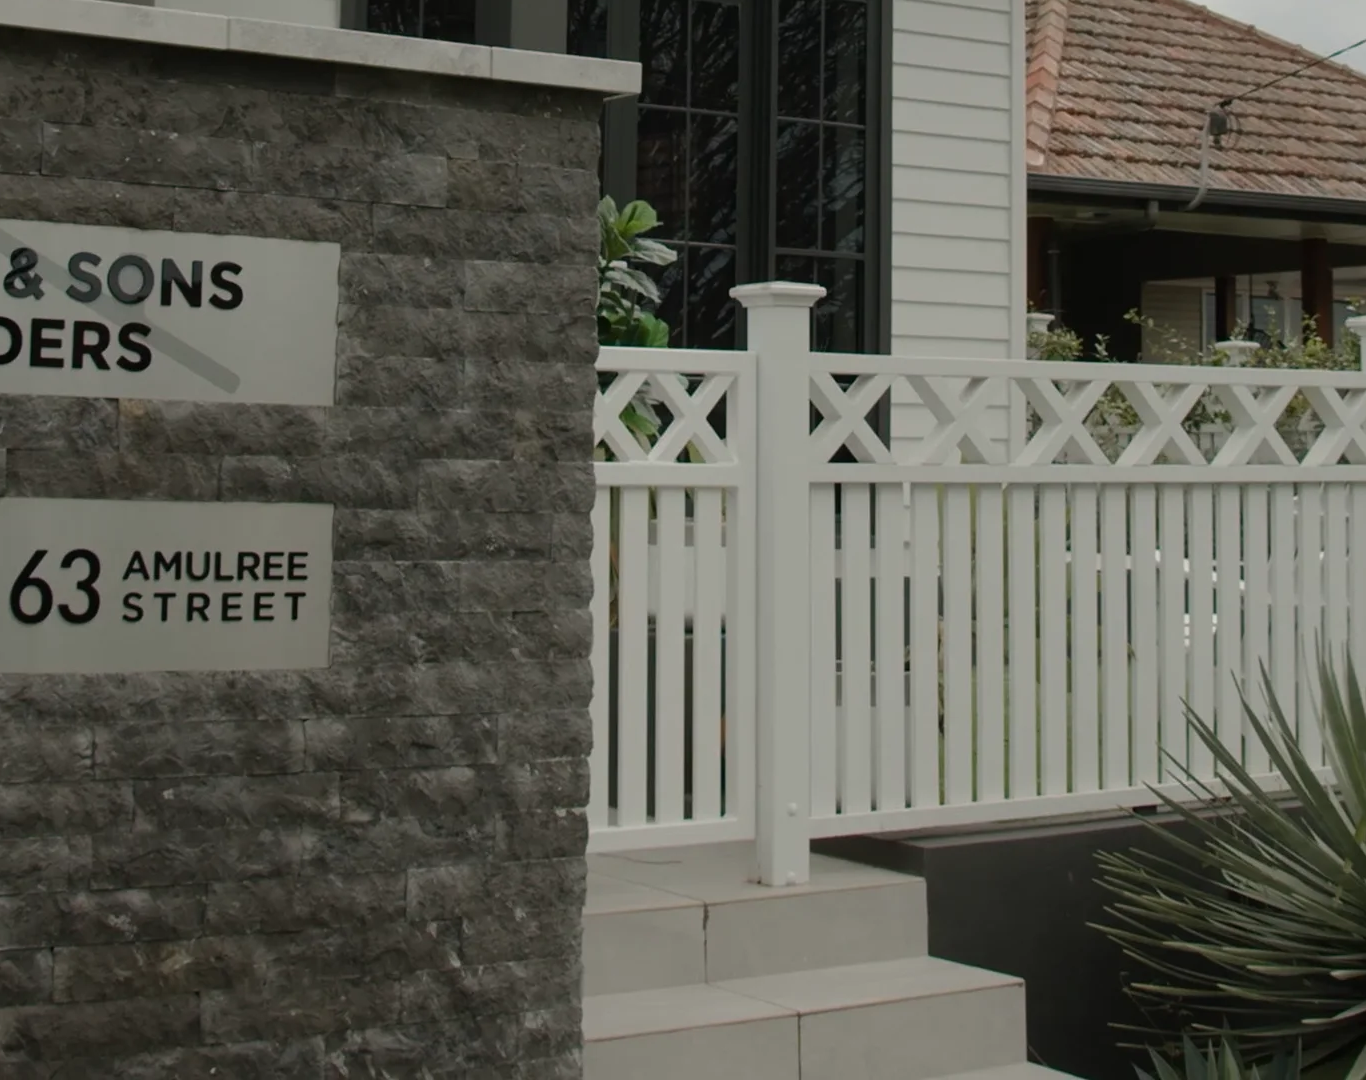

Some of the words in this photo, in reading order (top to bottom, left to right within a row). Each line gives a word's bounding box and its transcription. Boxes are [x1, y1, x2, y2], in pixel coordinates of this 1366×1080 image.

[2, 246, 45, 300] &
[66, 251, 245, 311] SONS
[8, 548, 102, 625] 63
[121, 550, 309, 583] AMULREE
[121, 591, 307, 624] STREET
